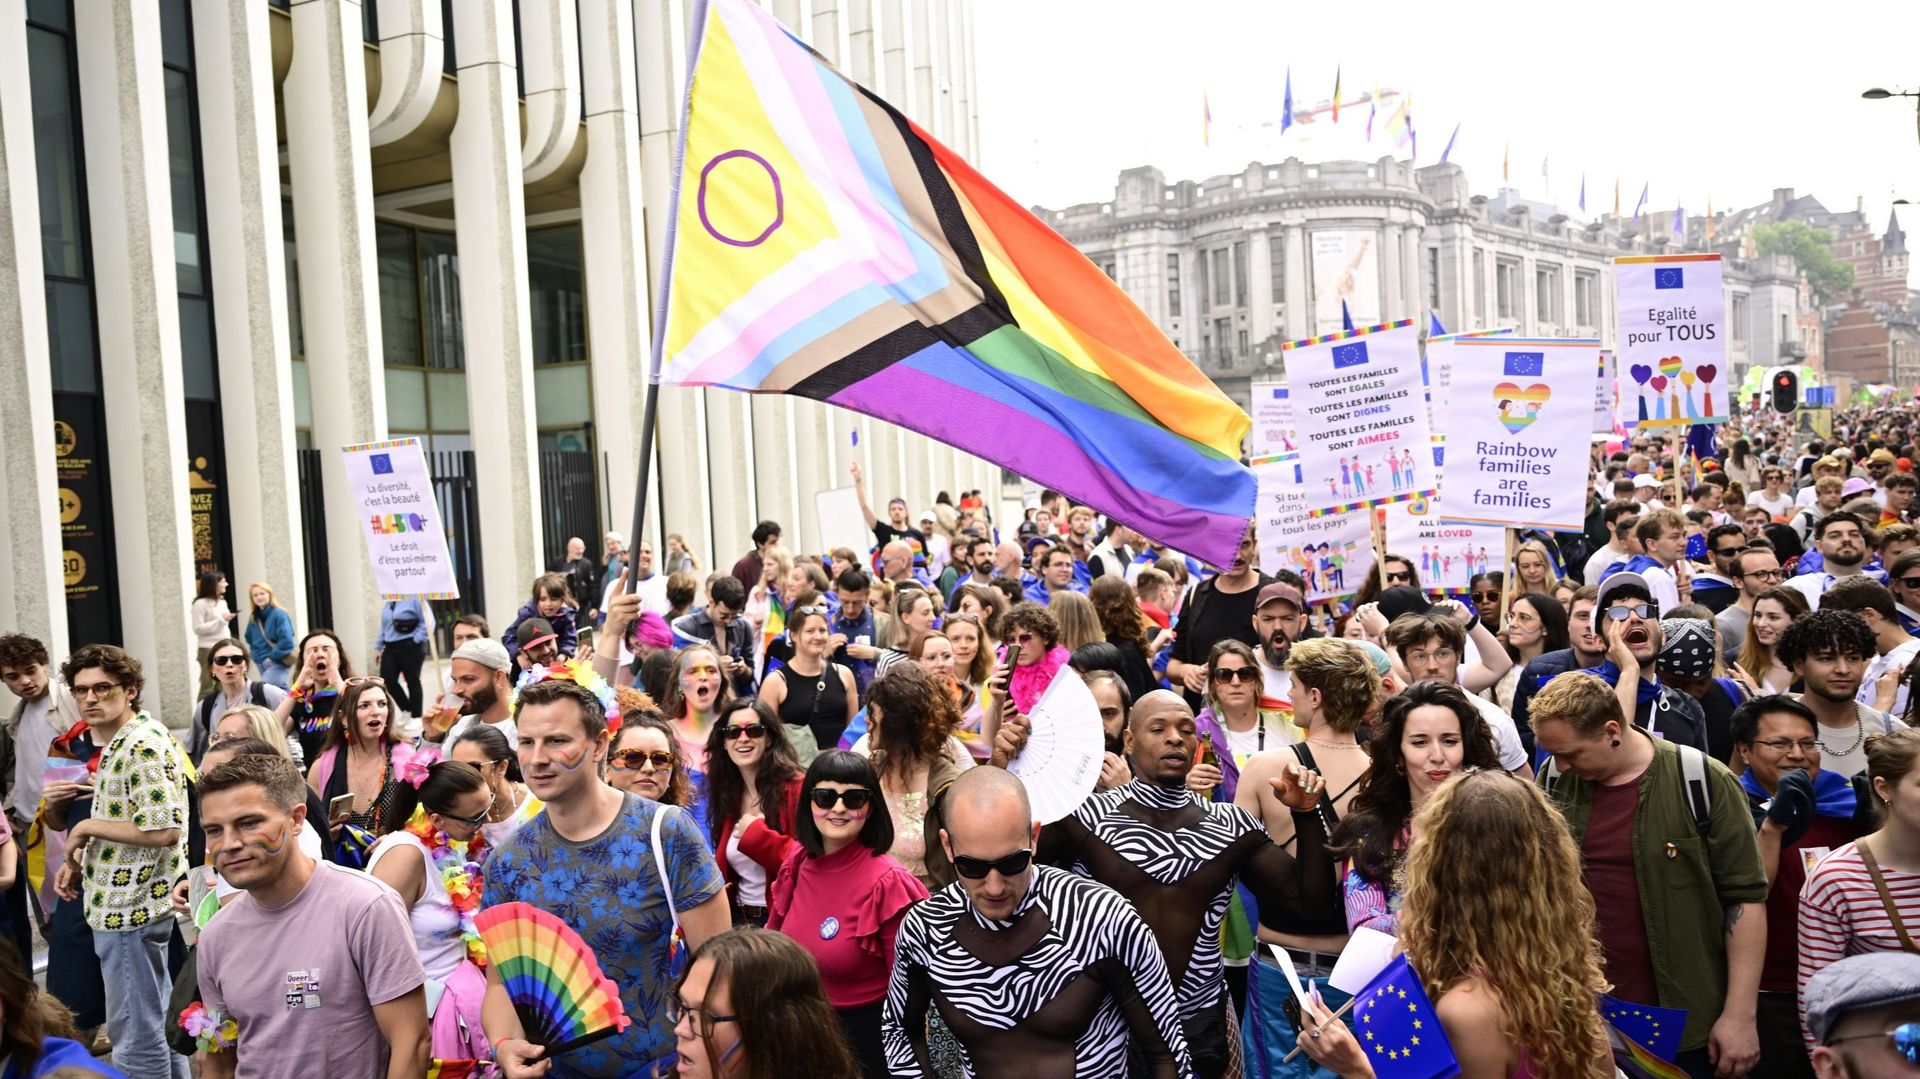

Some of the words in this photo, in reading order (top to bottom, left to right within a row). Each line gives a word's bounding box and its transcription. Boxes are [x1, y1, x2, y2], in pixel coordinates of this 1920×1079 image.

[1648, 306, 1697, 326] Egalité
[1628, 332, 1662, 347] pour
[1666, 324, 1716, 342] TOUS
[1308, 378, 1341, 389] TOUTES
[1342, 374, 1357, 383] LES
[1358, 366, 1398, 380] FAMILLES
[1325, 388, 1347, 398] SONT
[1308, 402, 1344, 414] TOUTES
[1346, 398, 1362, 408] LES
[1364, 390, 1408, 404] FAMILLES
[1326, 412, 1352, 423] SONT
[1354, 404, 1391, 418] DIGNES
[1309, 428, 1347, 442] TOUTES
[1349, 425, 1366, 434] LES
[1368, 416, 1415, 431] FAMILLES
[1328, 440, 1354, 452] SONT
[1476, 441, 1558, 458] Rainbow
[1479, 458, 1552, 475] families
[366, 484, 376, 494] La
[1498, 478, 1528, 491] are
[382, 495, 391, 505] la
[391, 492, 420, 504] beauté
[1275, 493, 1284, 502] Si
[1473, 489, 1552, 509] families
[1278, 504, 1302, 514] dans
[1282, 526, 1304, 535] tous
[1307, 522, 1322, 531] les
[1324, 518, 1348, 531] pays
[1438, 530, 1472, 538] LOVED
[390, 544, 400, 552] Le
[400, 542, 418, 551] droit
[394, 566, 426, 579] partout
